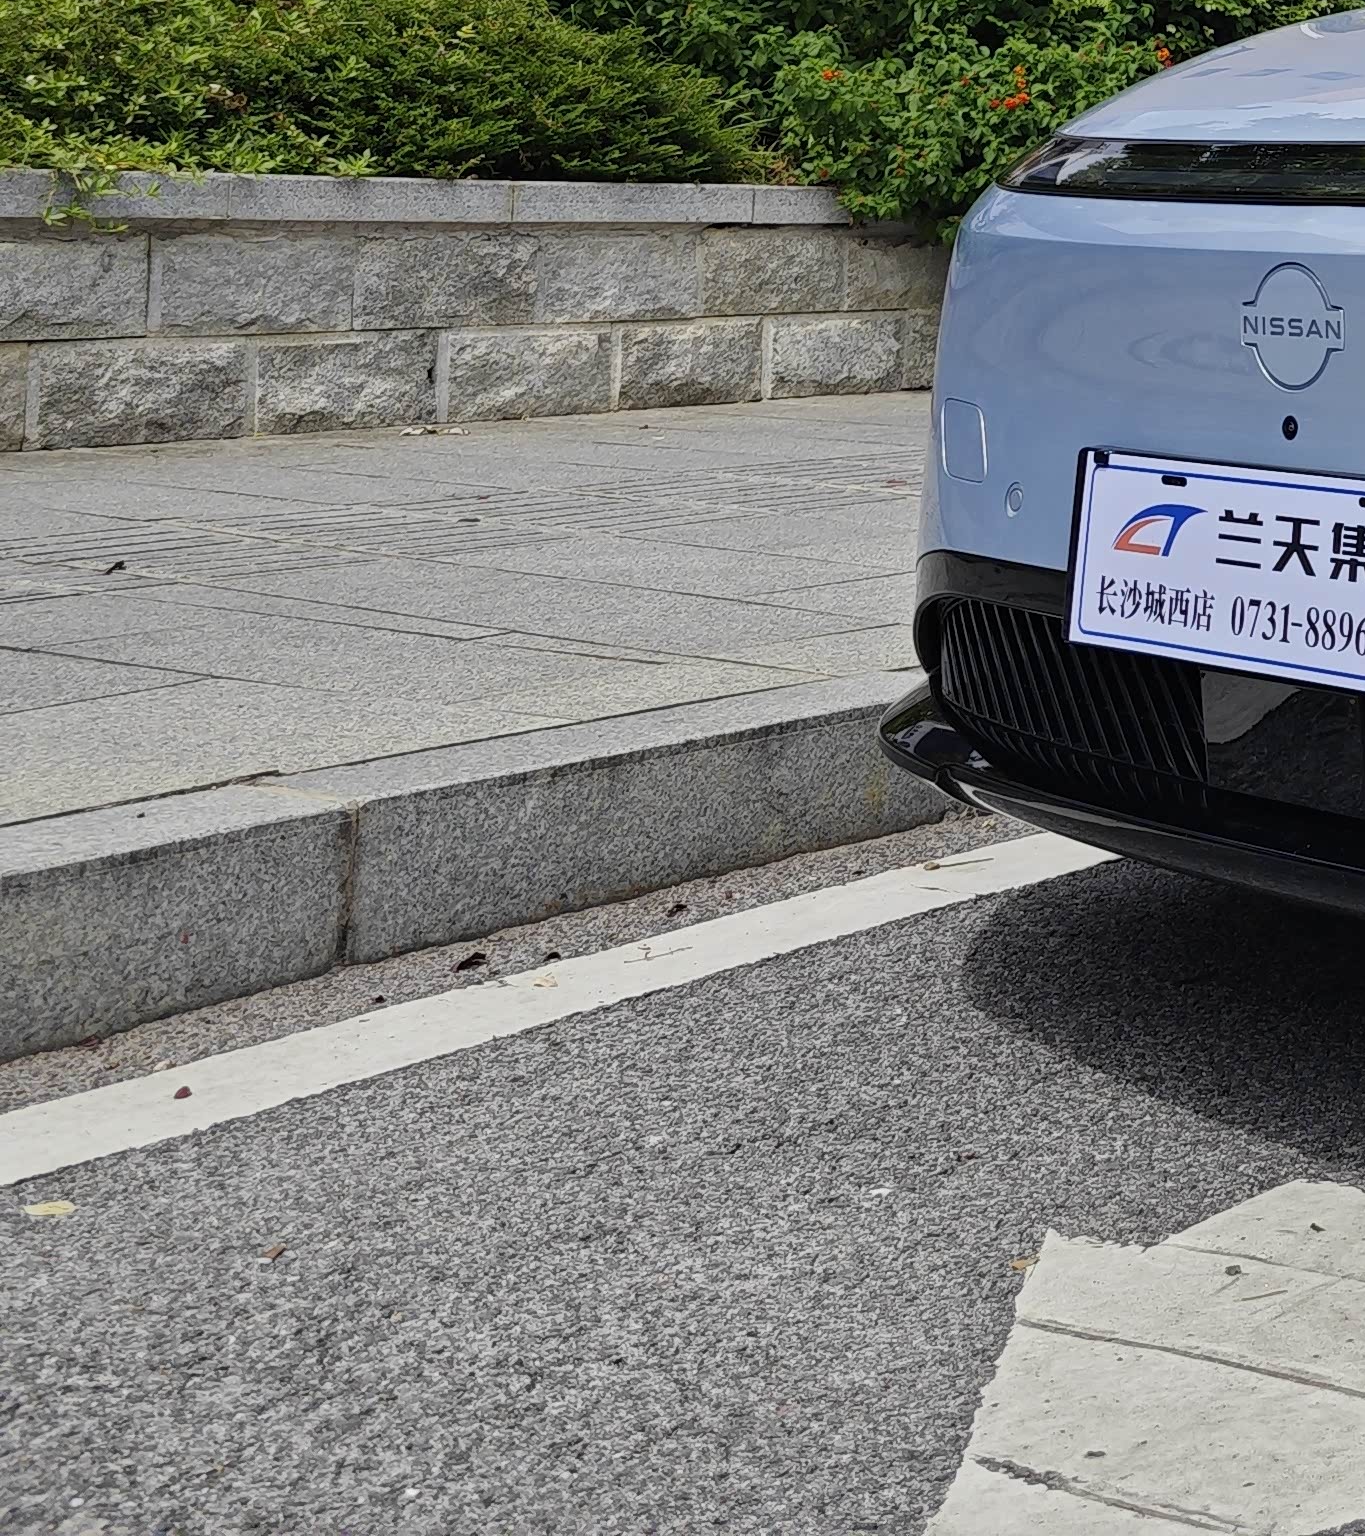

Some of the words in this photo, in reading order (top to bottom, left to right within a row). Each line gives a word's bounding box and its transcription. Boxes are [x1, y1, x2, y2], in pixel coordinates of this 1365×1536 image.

[1242, 314, 1342, 340] NISSAN
[1095, 574, 1217, 633] 长沙城西店
